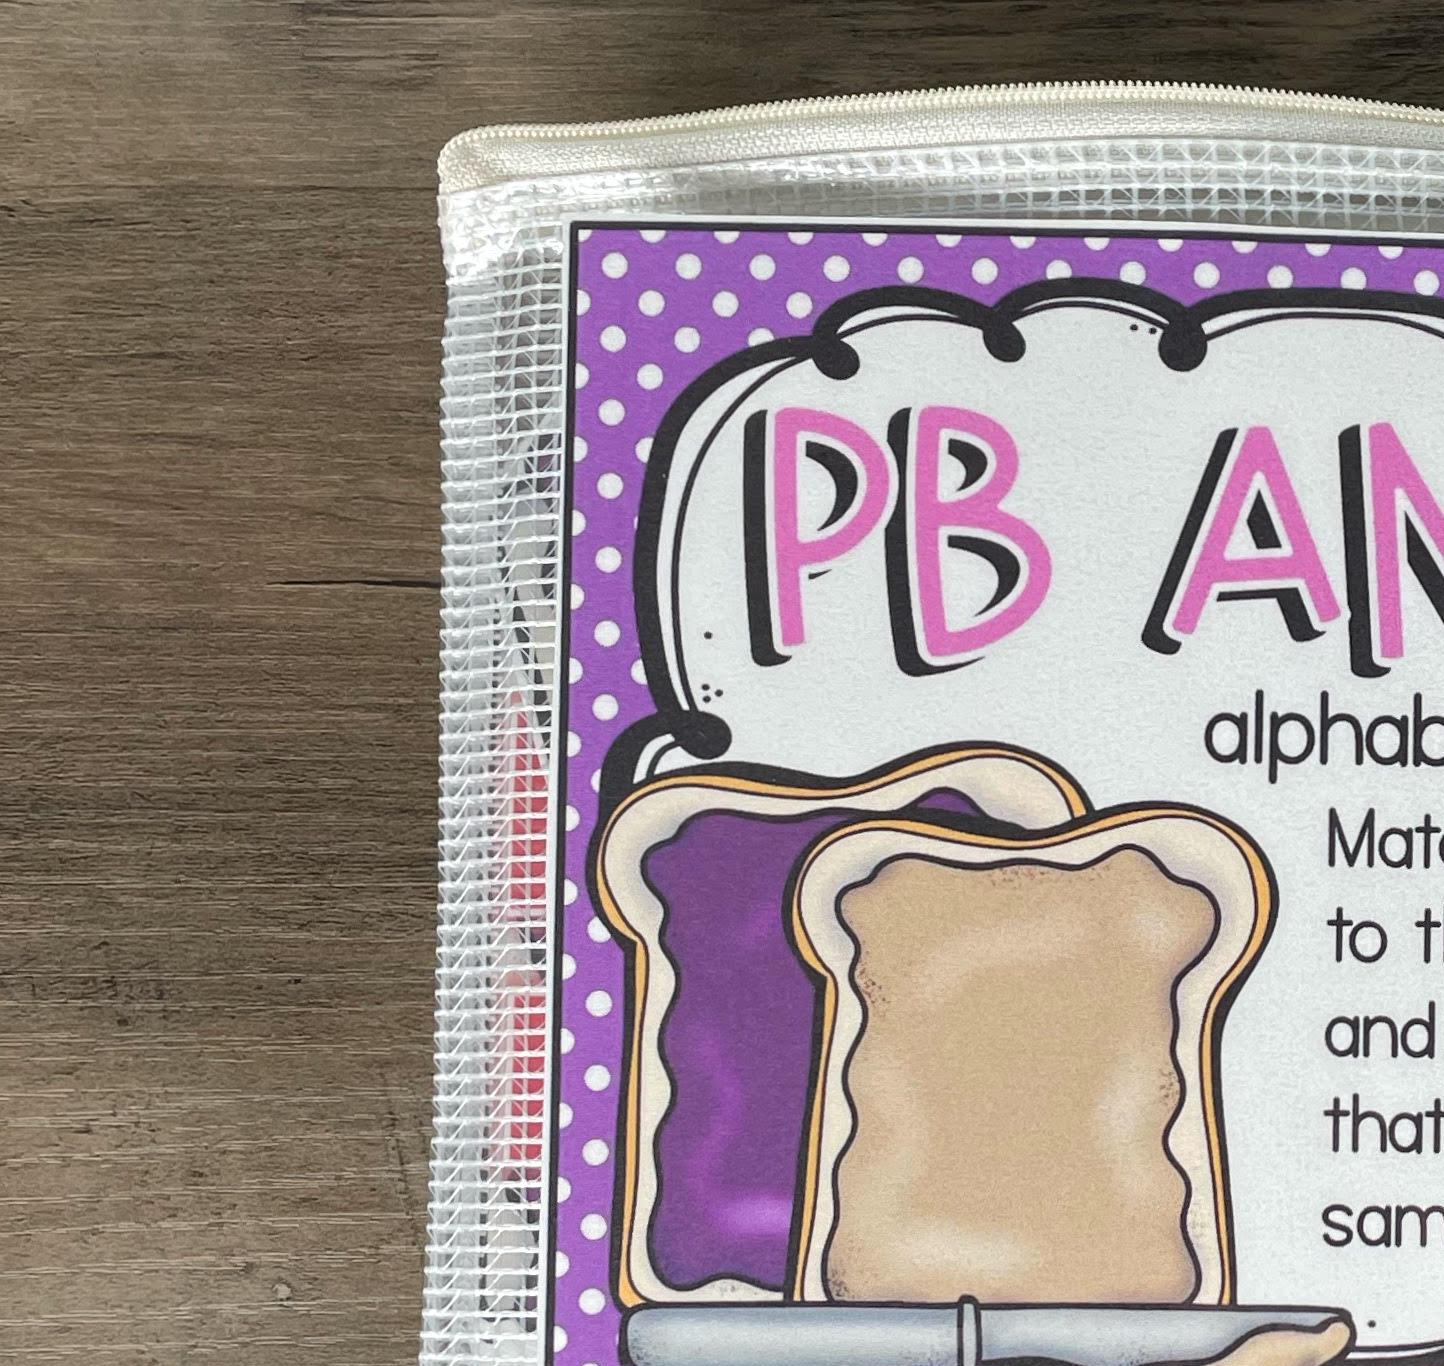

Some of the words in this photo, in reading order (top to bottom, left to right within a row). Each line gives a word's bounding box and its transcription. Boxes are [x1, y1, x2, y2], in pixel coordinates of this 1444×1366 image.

[742, 404, 1052, 678] PB
[1327, 907, 1387, 963] to
[1325, 1001, 1435, 1059] and
